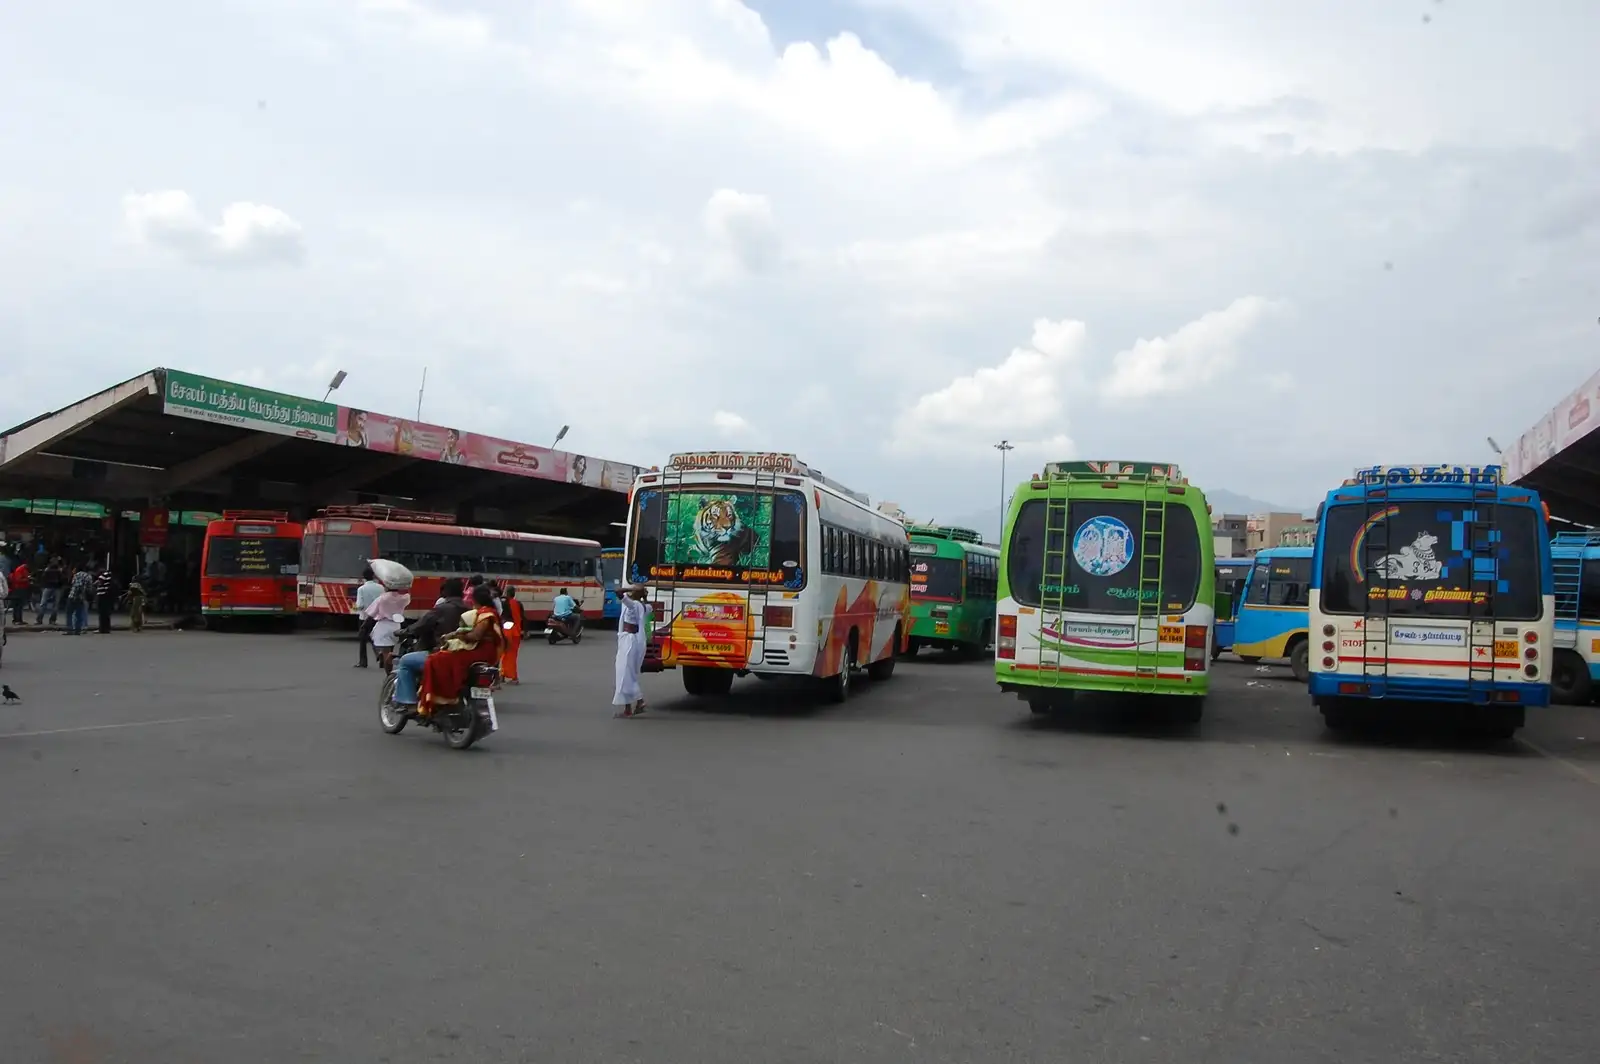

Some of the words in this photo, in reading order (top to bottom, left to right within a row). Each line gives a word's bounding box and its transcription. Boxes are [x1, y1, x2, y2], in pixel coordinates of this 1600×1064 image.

[170, 380, 207, 403] சேலம்
[209, 389, 247, 411] மத்திய
[248, 396, 290, 422] பேருந்து
[291, 405, 336, 428] நிலையம்
[1038, 583, 1081, 594] சேலம்
